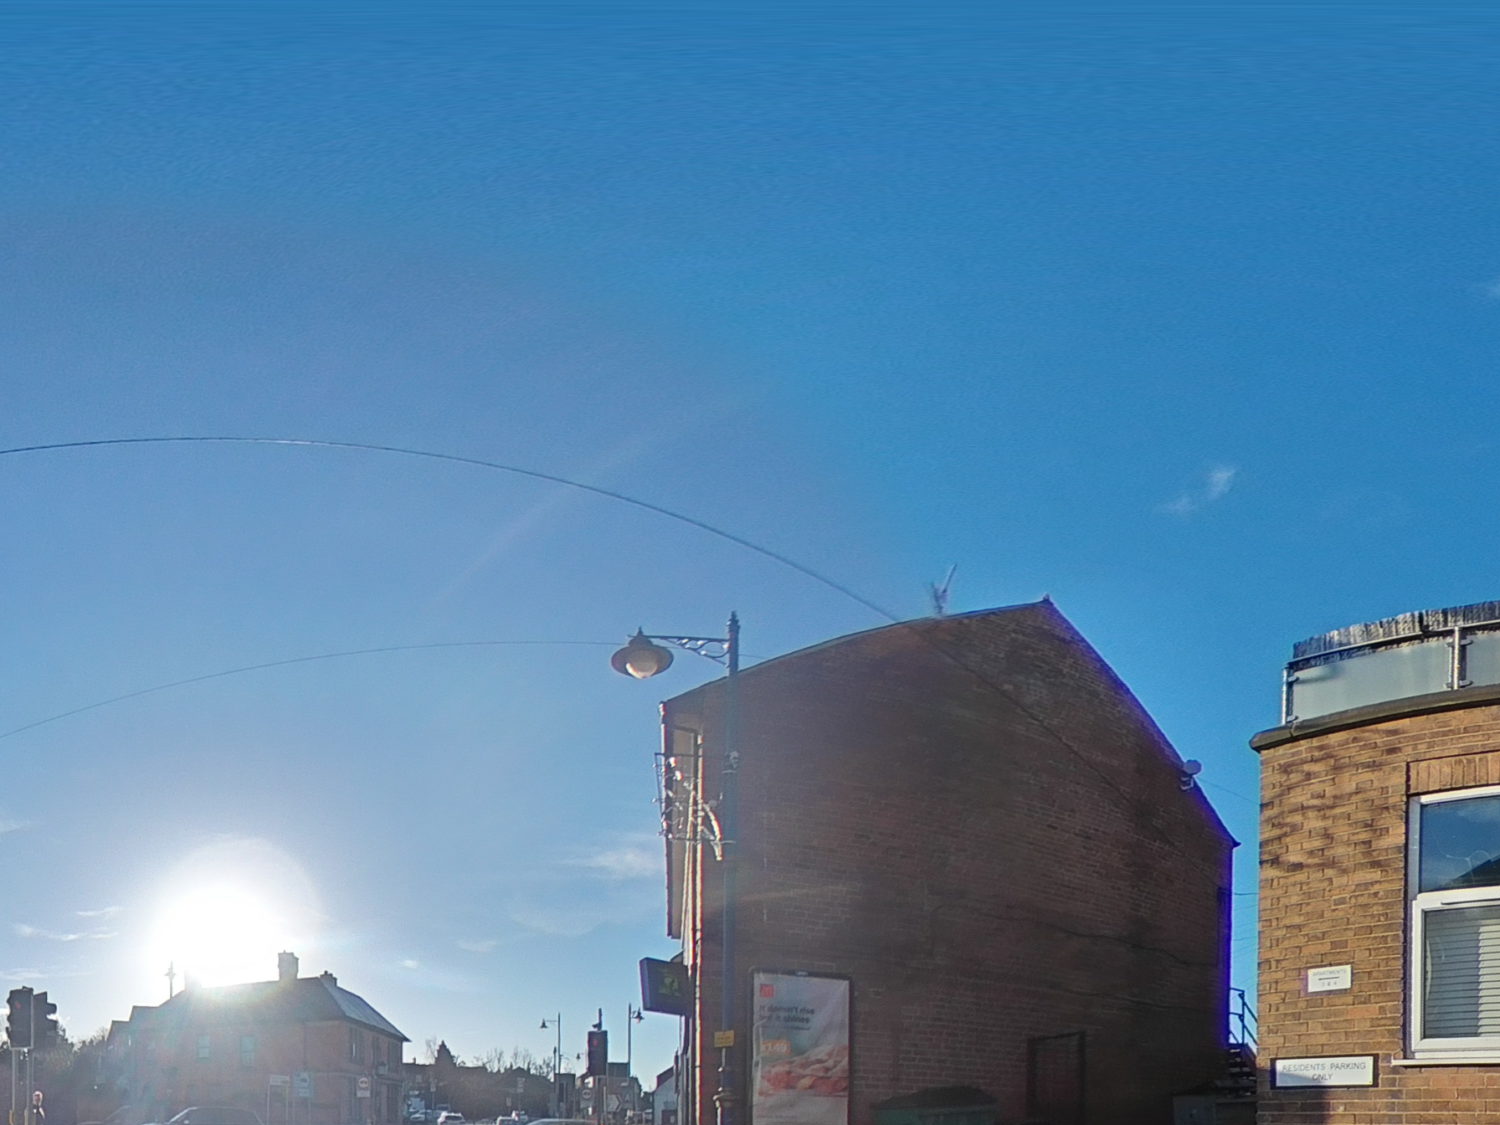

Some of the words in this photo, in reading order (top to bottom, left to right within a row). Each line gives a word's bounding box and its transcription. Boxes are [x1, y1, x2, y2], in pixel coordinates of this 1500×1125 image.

[1281, 1063, 1326, 1073] RESIDENTS
[1330, 1061, 1366, 1071] PARKING
[1311, 1073, 1334, 1081] ONLY
